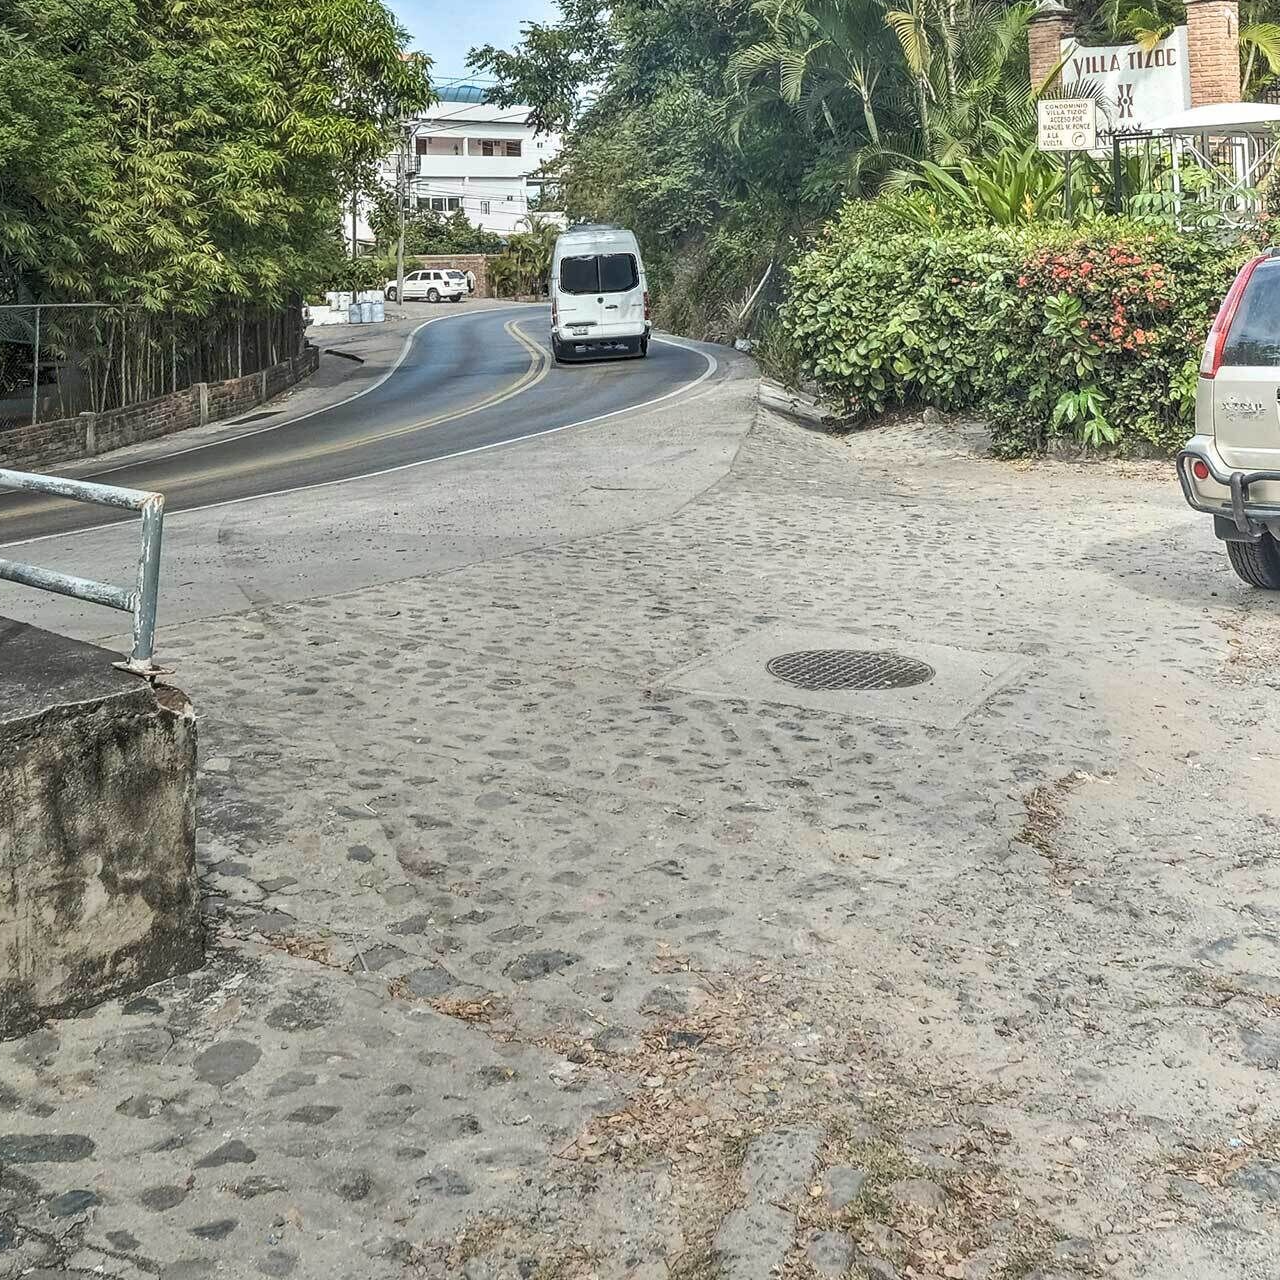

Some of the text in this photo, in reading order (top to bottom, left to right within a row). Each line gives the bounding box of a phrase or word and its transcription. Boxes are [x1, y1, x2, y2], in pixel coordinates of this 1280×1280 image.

[1073, 48, 1177, 80] VILLA TIZOC
[1045, 102, 1088, 110] CONDOMINIO
